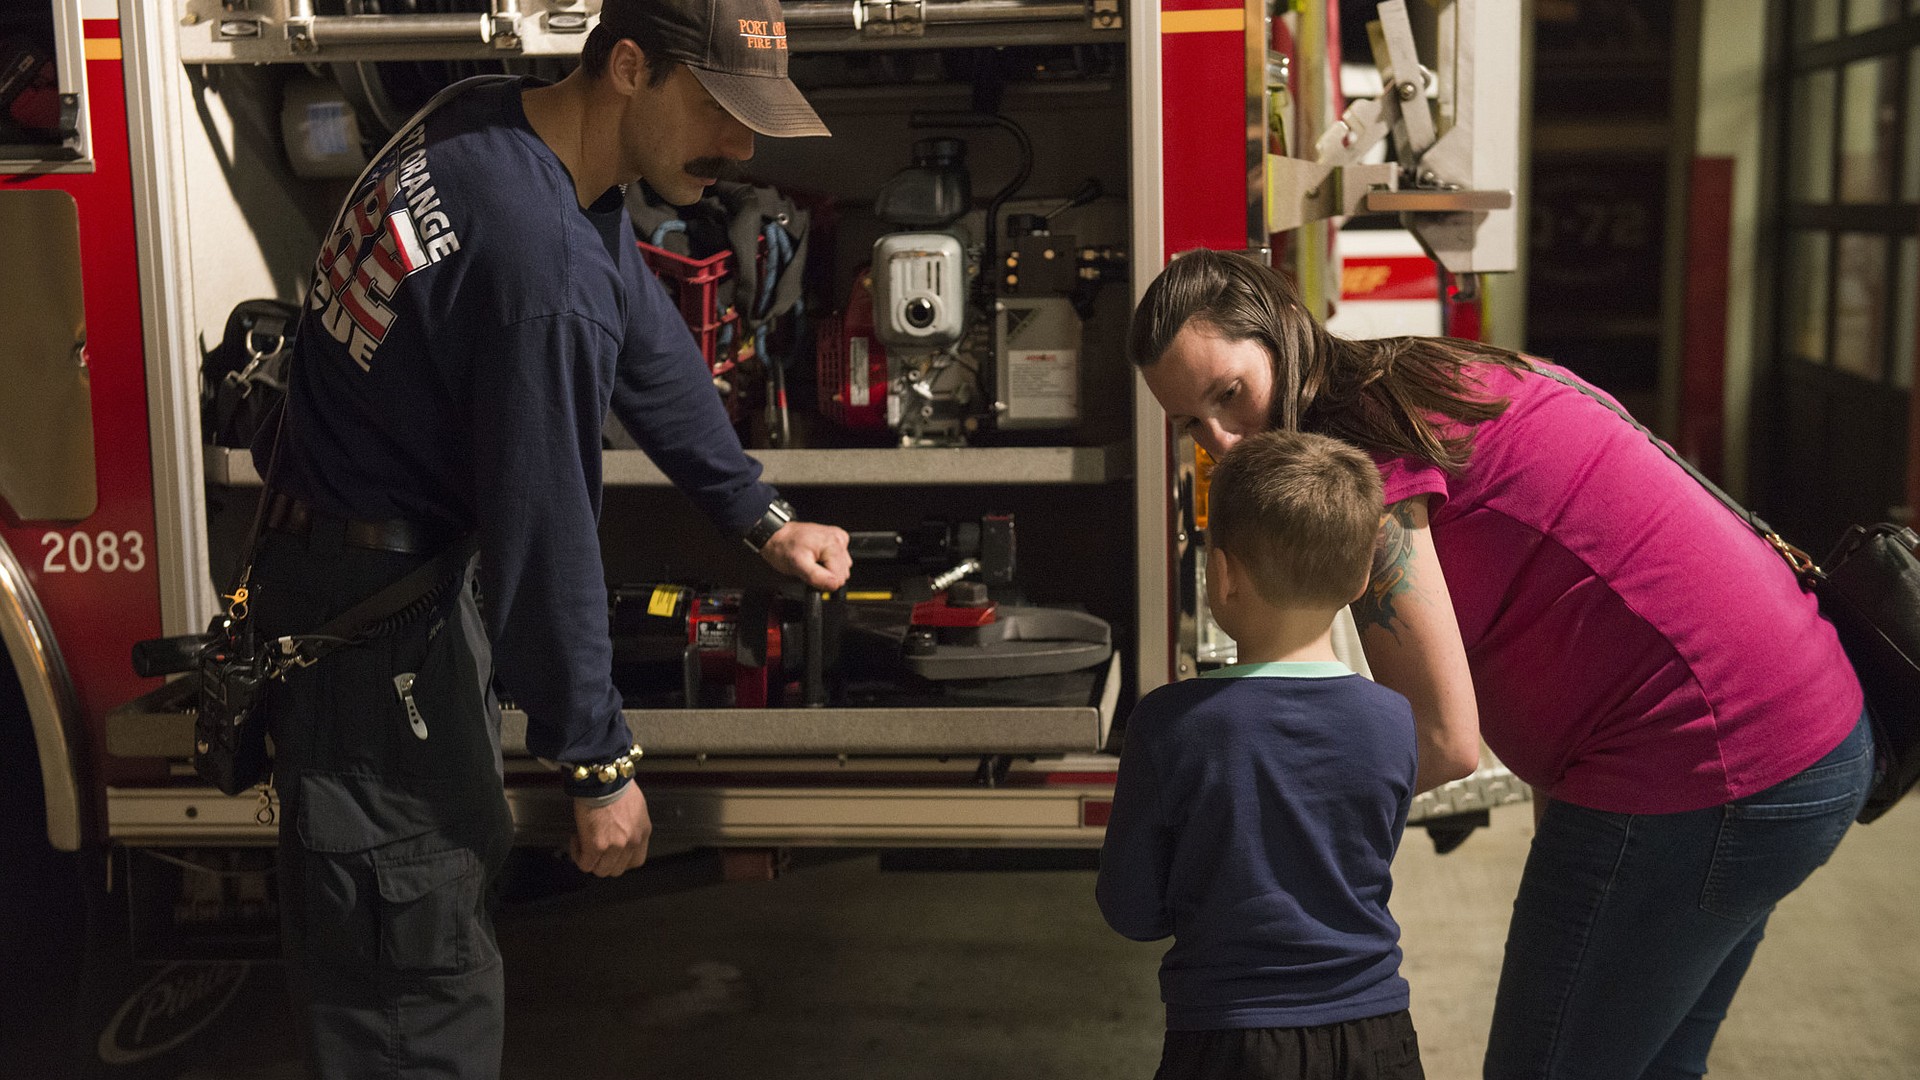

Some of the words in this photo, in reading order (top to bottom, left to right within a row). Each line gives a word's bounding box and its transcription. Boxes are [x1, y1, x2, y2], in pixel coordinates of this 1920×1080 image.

[738, 19, 768, 35] PORT
[747, 37, 772, 49] FIRE
[399, 121, 425, 154] RT
[400, 149, 462, 264] ORANGE
[310, 268, 380, 374] CUE
[40, 529, 146, 574] 2083
